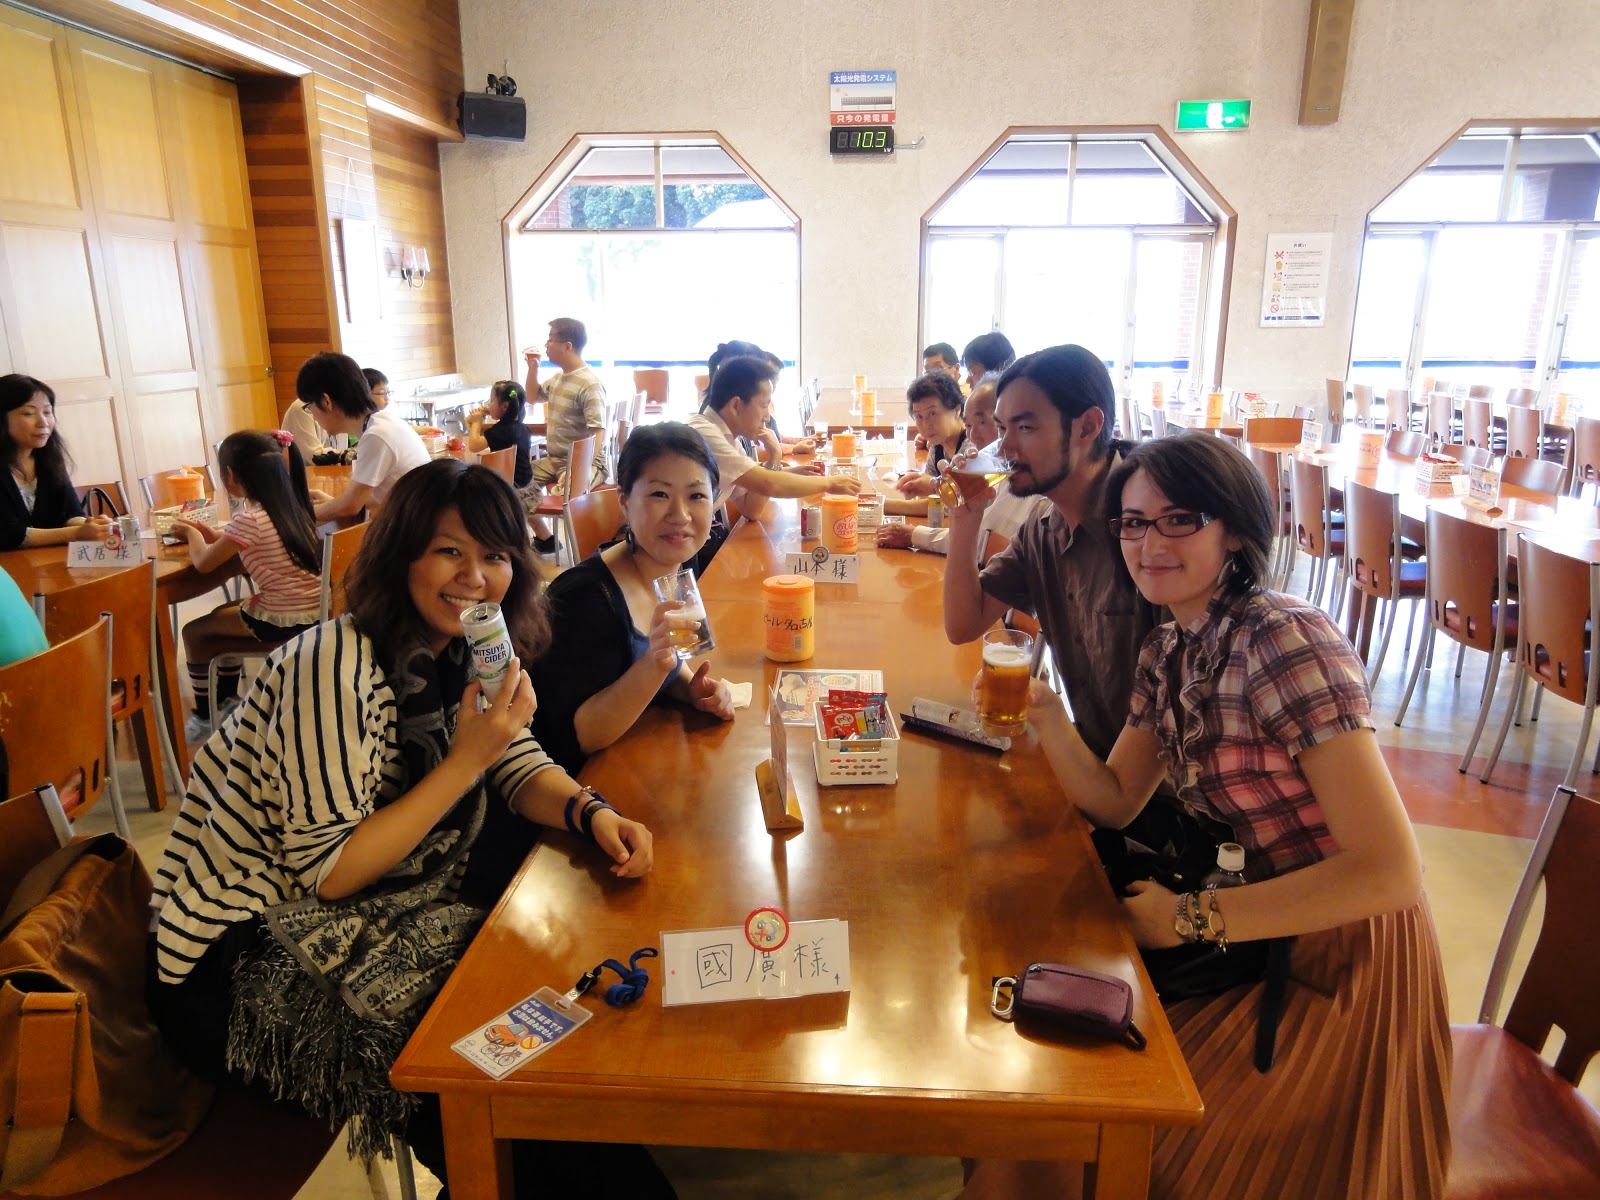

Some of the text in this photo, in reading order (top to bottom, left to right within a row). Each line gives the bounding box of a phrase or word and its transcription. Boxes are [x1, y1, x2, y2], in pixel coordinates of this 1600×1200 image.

[833, 74, 893, 83] 太陽光発電システム
[837, 114, 889, 123] 只今の発電量
[856, 131, 887, 148] 10.3
[473, 642, 506, 657] MITSUYA
[484, 650, 507, 664] CIDER
